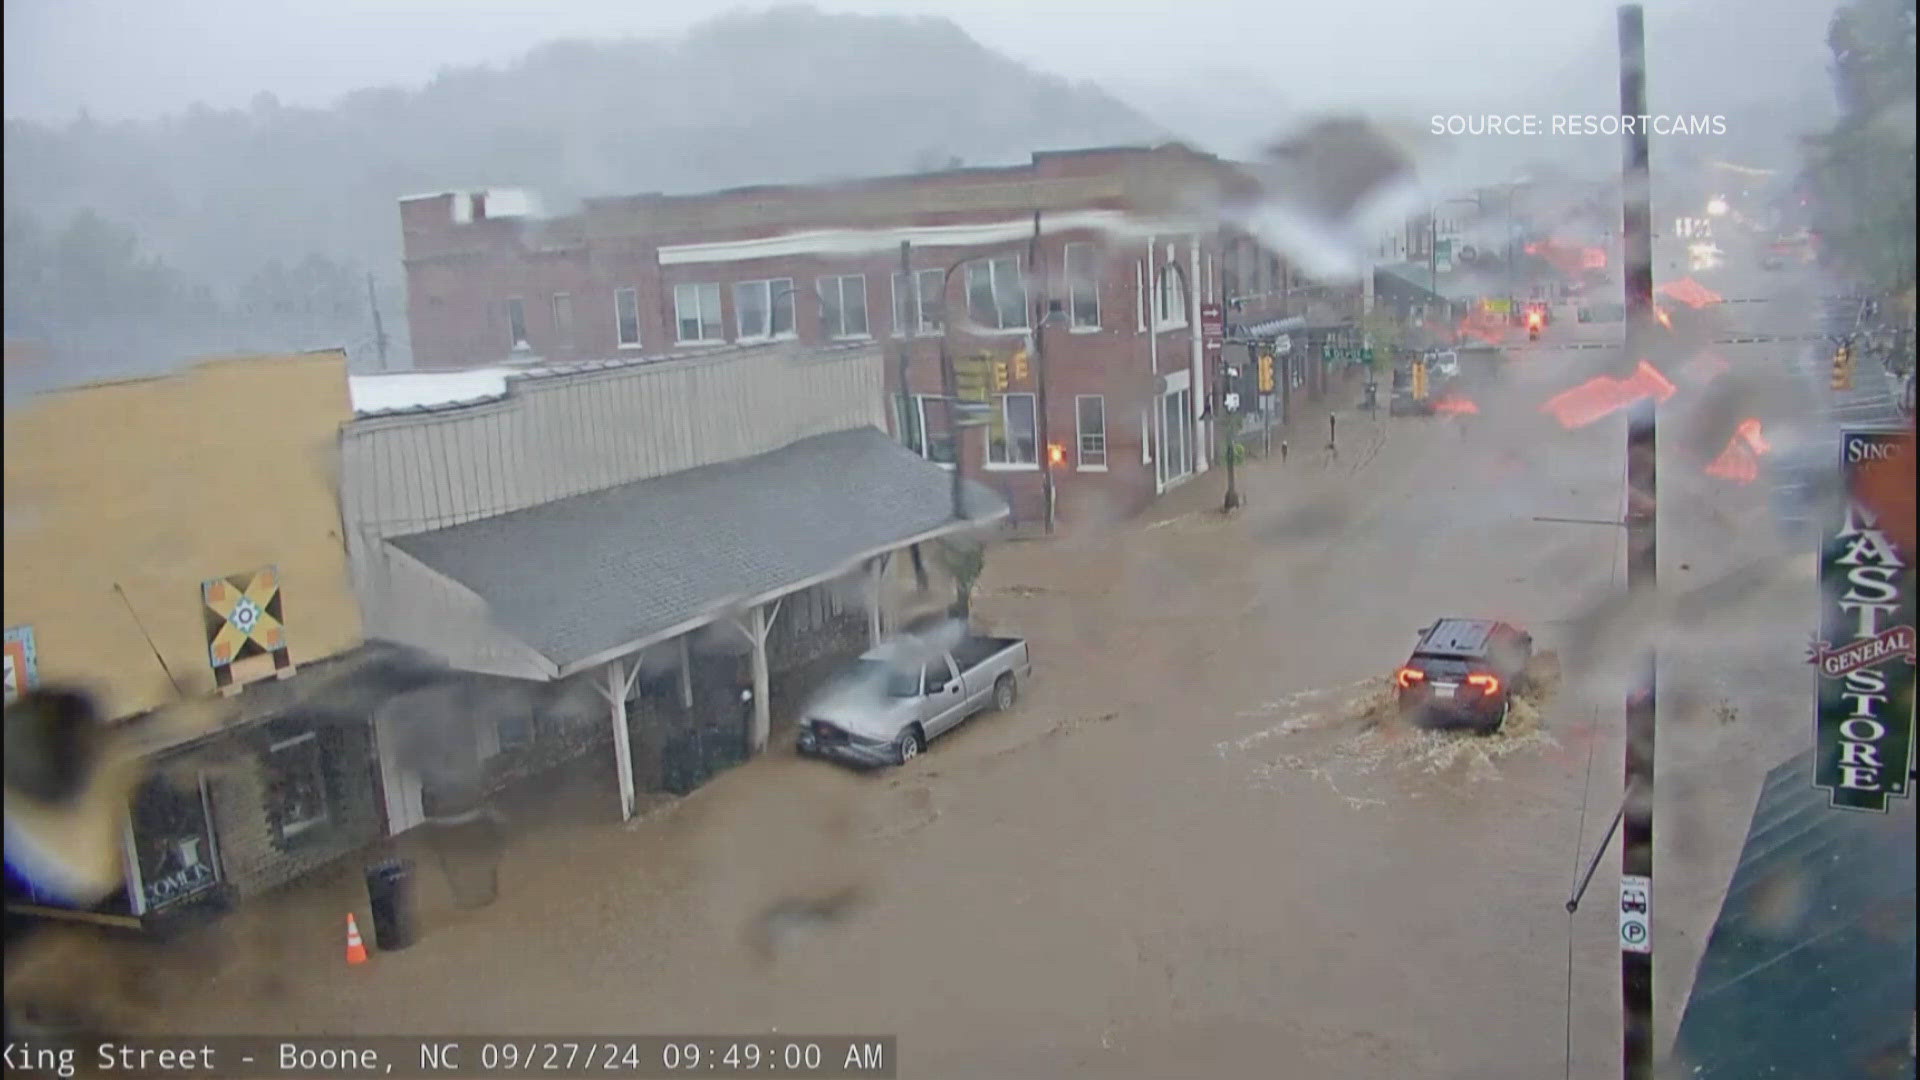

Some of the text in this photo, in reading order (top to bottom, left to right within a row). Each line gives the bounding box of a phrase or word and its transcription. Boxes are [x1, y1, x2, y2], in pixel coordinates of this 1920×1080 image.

[1848, 438, 1903, 462] SINC
[1825, 632, 1910, 674] GENERAL
[1838, 668, 1887, 791] STORE
